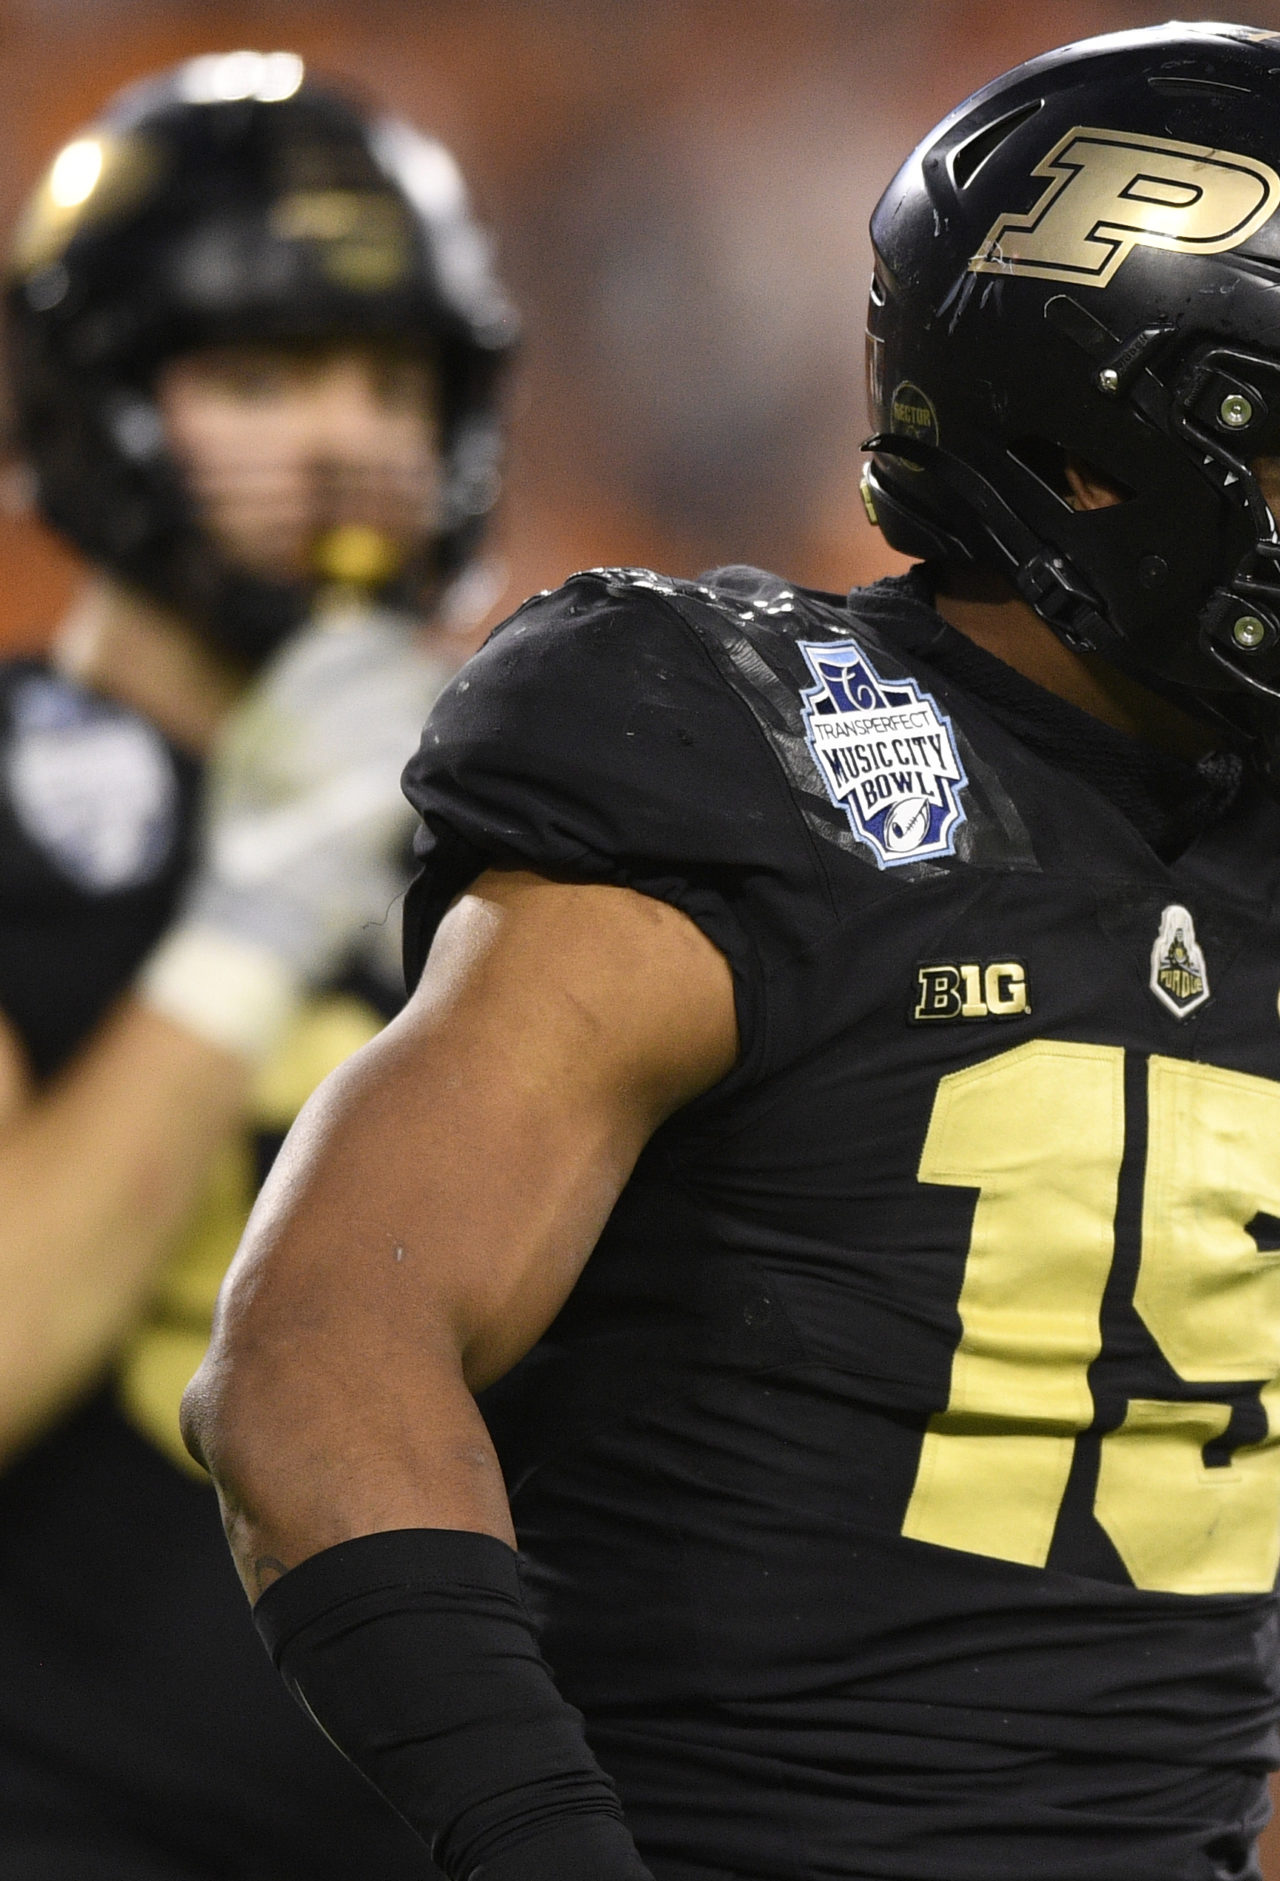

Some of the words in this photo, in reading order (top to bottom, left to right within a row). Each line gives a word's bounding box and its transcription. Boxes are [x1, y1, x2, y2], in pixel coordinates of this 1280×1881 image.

[814, 710, 931, 741] TRANSPERFECT
[822, 738, 893, 789] MUSIC
[890, 733, 948, 771] CITY
[860, 770, 936, 810] BOWL
[1160, 969, 1203, 999] PURDUE
